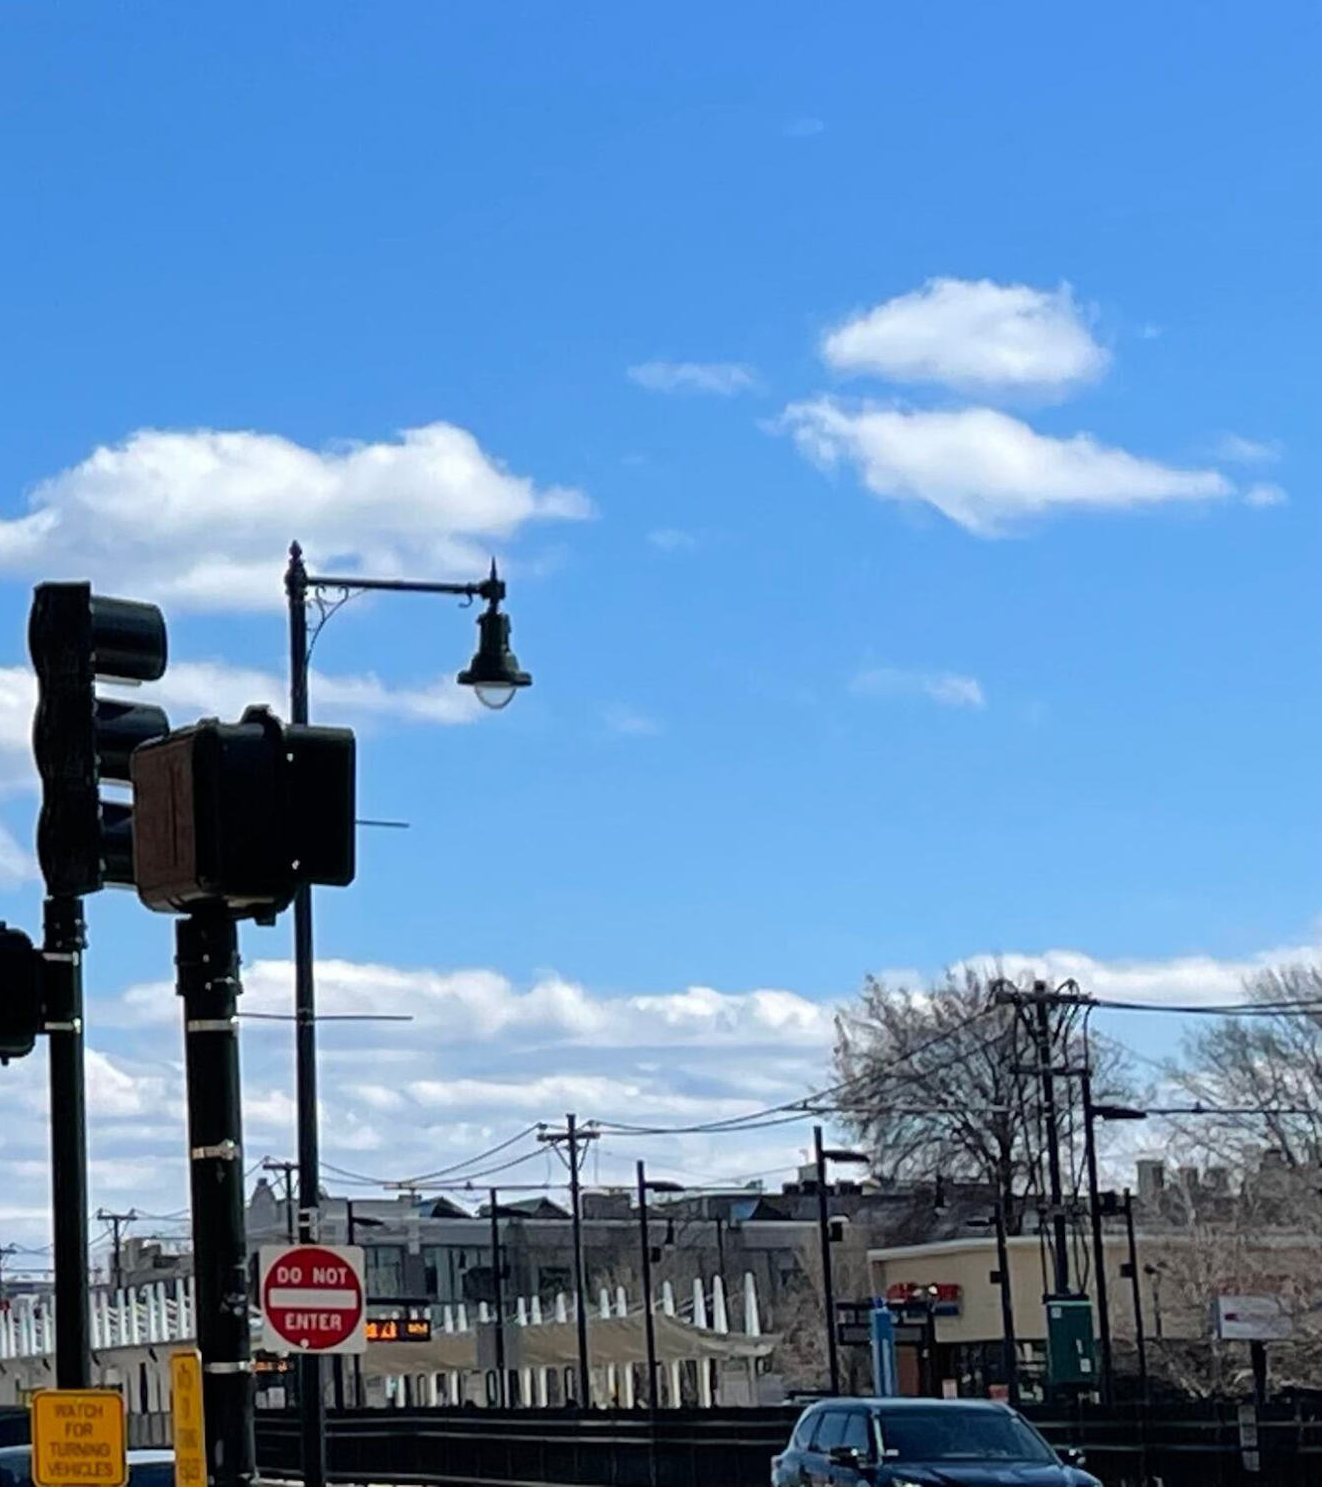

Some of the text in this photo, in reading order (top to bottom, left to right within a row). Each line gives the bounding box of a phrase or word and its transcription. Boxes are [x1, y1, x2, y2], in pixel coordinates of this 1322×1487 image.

[277, 1267, 347, 1284] DO NOT
[285, 1314, 342, 1331] ENTER
[52, 1403, 104, 1418] WATCH
[64, 1422, 94, 1437] FOR
[50, 1443, 111, 1457] TURNING
[47, 1462, 114, 1478] VEHICLES
